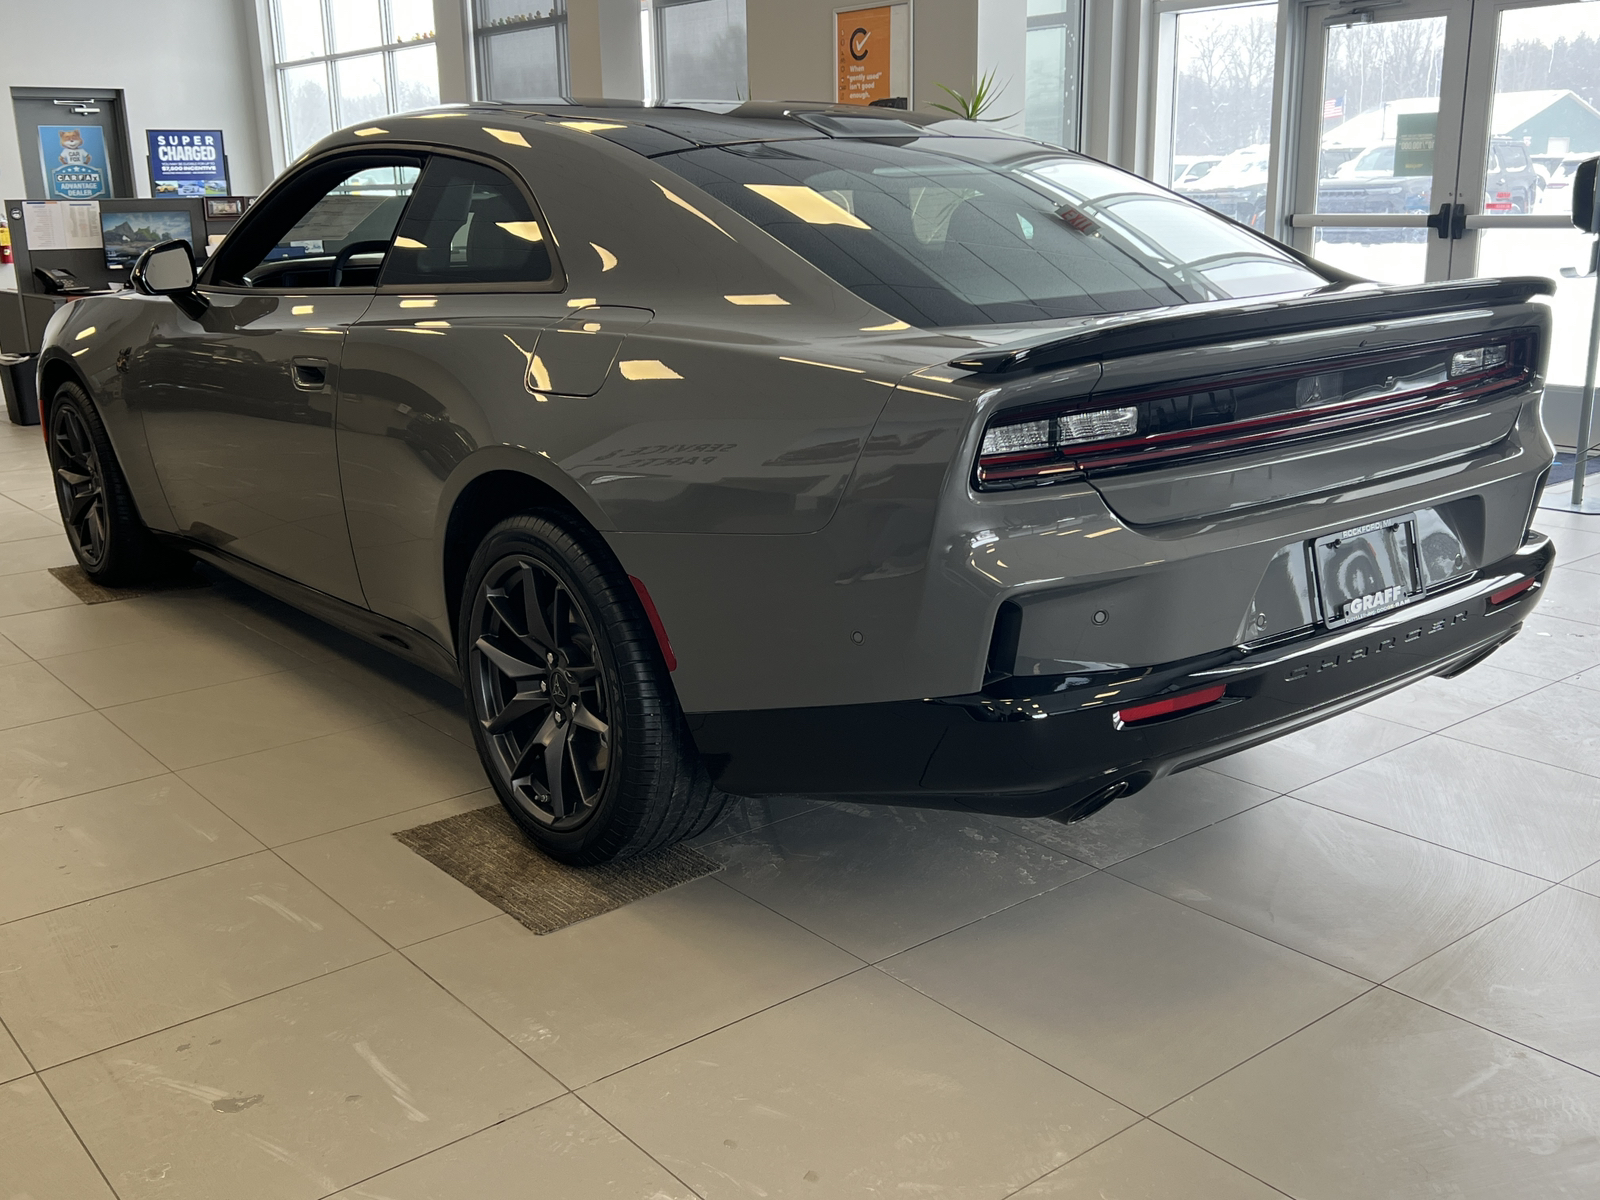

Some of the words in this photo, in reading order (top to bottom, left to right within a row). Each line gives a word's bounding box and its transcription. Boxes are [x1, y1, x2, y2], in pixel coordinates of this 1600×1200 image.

[849, 65, 865, 73] When
[861, 81, 875, 91] good
[157, 135, 214, 146] SUPER
[158, 146, 216, 161] CHARGED
[56, 174, 100, 182] CARFAX
[61, 182, 98, 190] ADVANTAGE
[1061, 208, 1093, 232] EXIT
[1350, 585, 1402, 614] GRAFF
[1284, 610, 1468, 682] CHARGER
